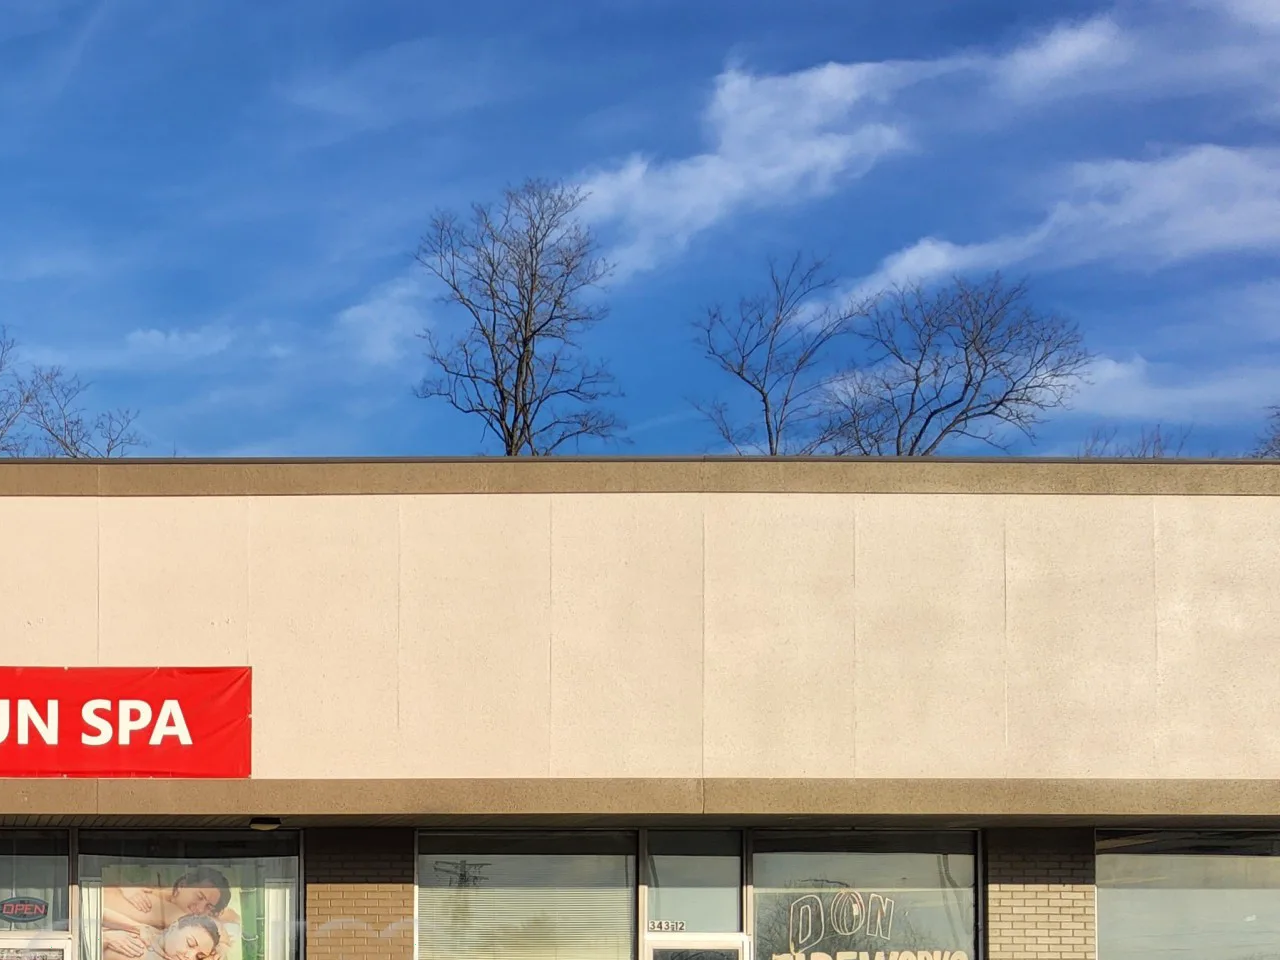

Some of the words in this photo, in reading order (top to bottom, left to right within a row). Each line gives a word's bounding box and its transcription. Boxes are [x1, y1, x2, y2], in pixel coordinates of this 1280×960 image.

[81, 699, 193, 746] SPA
[2, 903, 45, 915] OPEN
[789, 889, 895, 956] DON
[649, 921, 685, 931] 343-12
